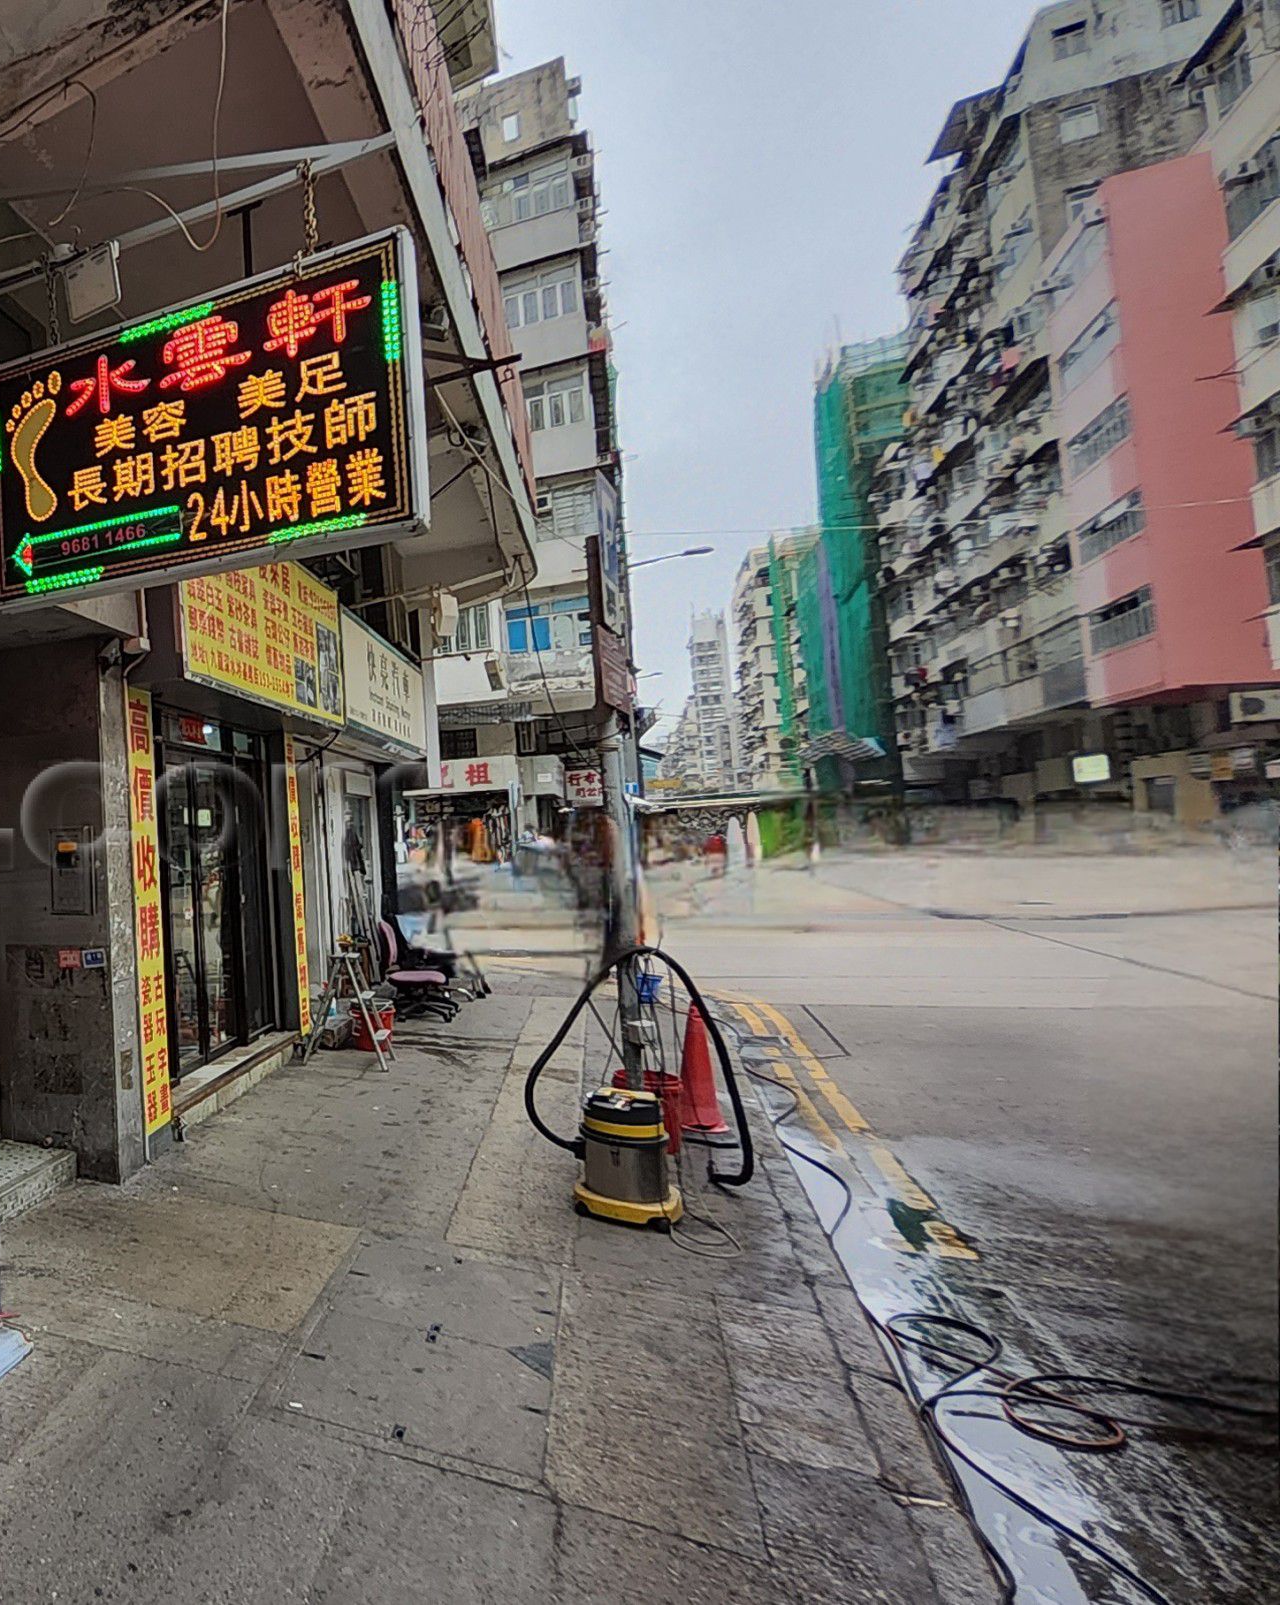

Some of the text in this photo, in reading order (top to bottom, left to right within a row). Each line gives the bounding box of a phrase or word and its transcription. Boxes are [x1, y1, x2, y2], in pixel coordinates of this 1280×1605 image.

[66, 279, 372, 416] 水雲軒
[67, 390, 378, 512] 長期招聘技師
[93, 352, 348, 459] 美容 美足
[61, 522, 147, 556] 9681 1466
[187, 448, 387, 542] 24小時營業
[128, 698, 161, 960] 高價收購
